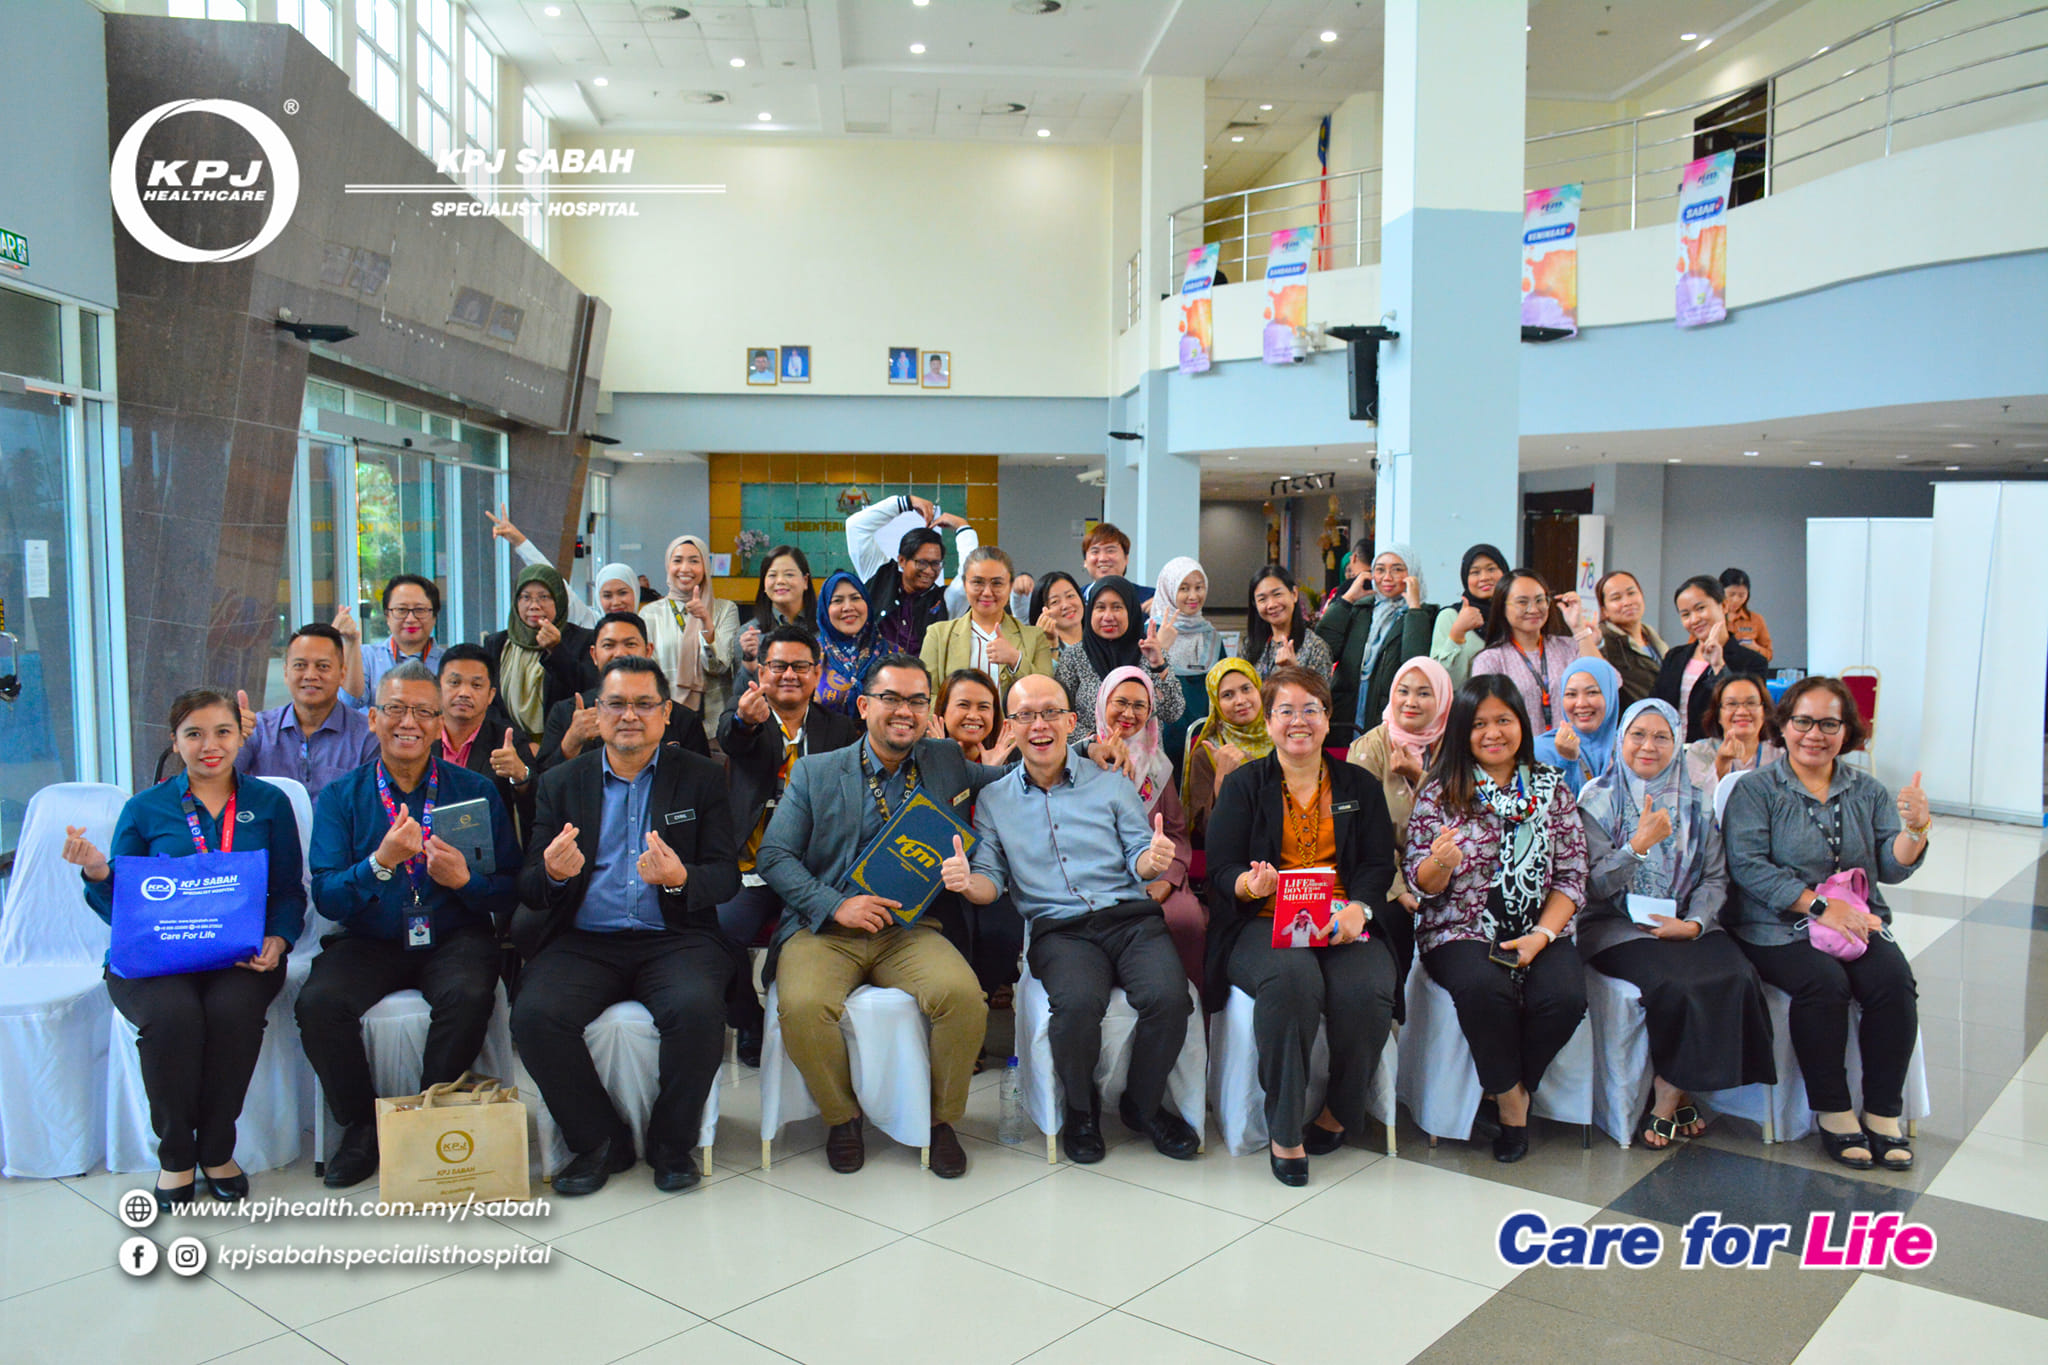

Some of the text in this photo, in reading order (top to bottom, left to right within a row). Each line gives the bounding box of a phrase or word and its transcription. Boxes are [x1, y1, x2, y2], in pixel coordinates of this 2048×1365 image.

[784, 521, 846, 532] KEMENTERI
[181, 875, 238, 888] KPJ SABAH
[160, 930, 216, 940] Care For Life
